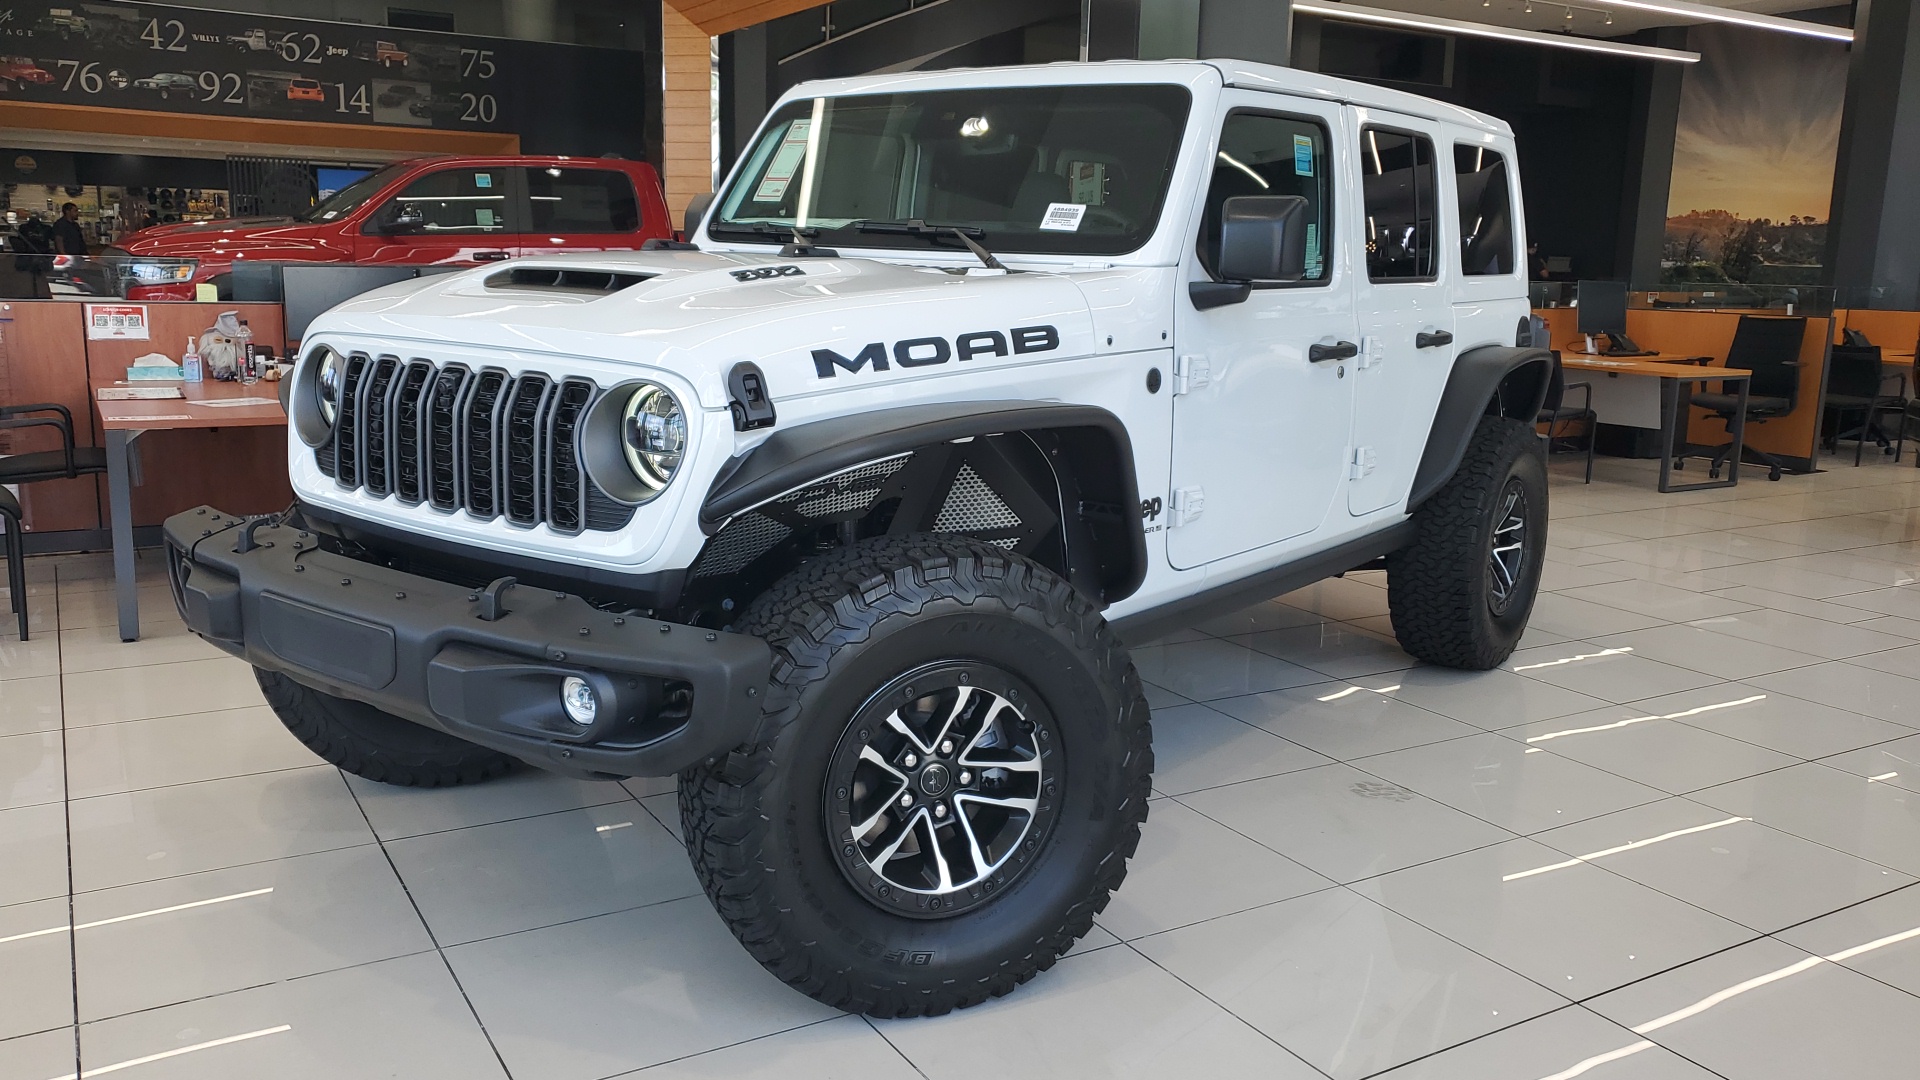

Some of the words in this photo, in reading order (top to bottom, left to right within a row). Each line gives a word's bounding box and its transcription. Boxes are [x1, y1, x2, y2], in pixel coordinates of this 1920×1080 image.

[0, 28, 34, 37] AGE
[140, 18, 187, 52] 42
[280, 31, 323, 64] 62
[326, 45, 349, 57] Jeep
[460, 48, 496, 79] 75
[57, 59, 103, 94] 76
[198, 70, 244, 104] 92
[334, 82, 371, 115] 14
[460, 93, 497, 123] 20
[810, 324, 1060, 380] MOAB
[1140, 496, 1163, 522] ep
